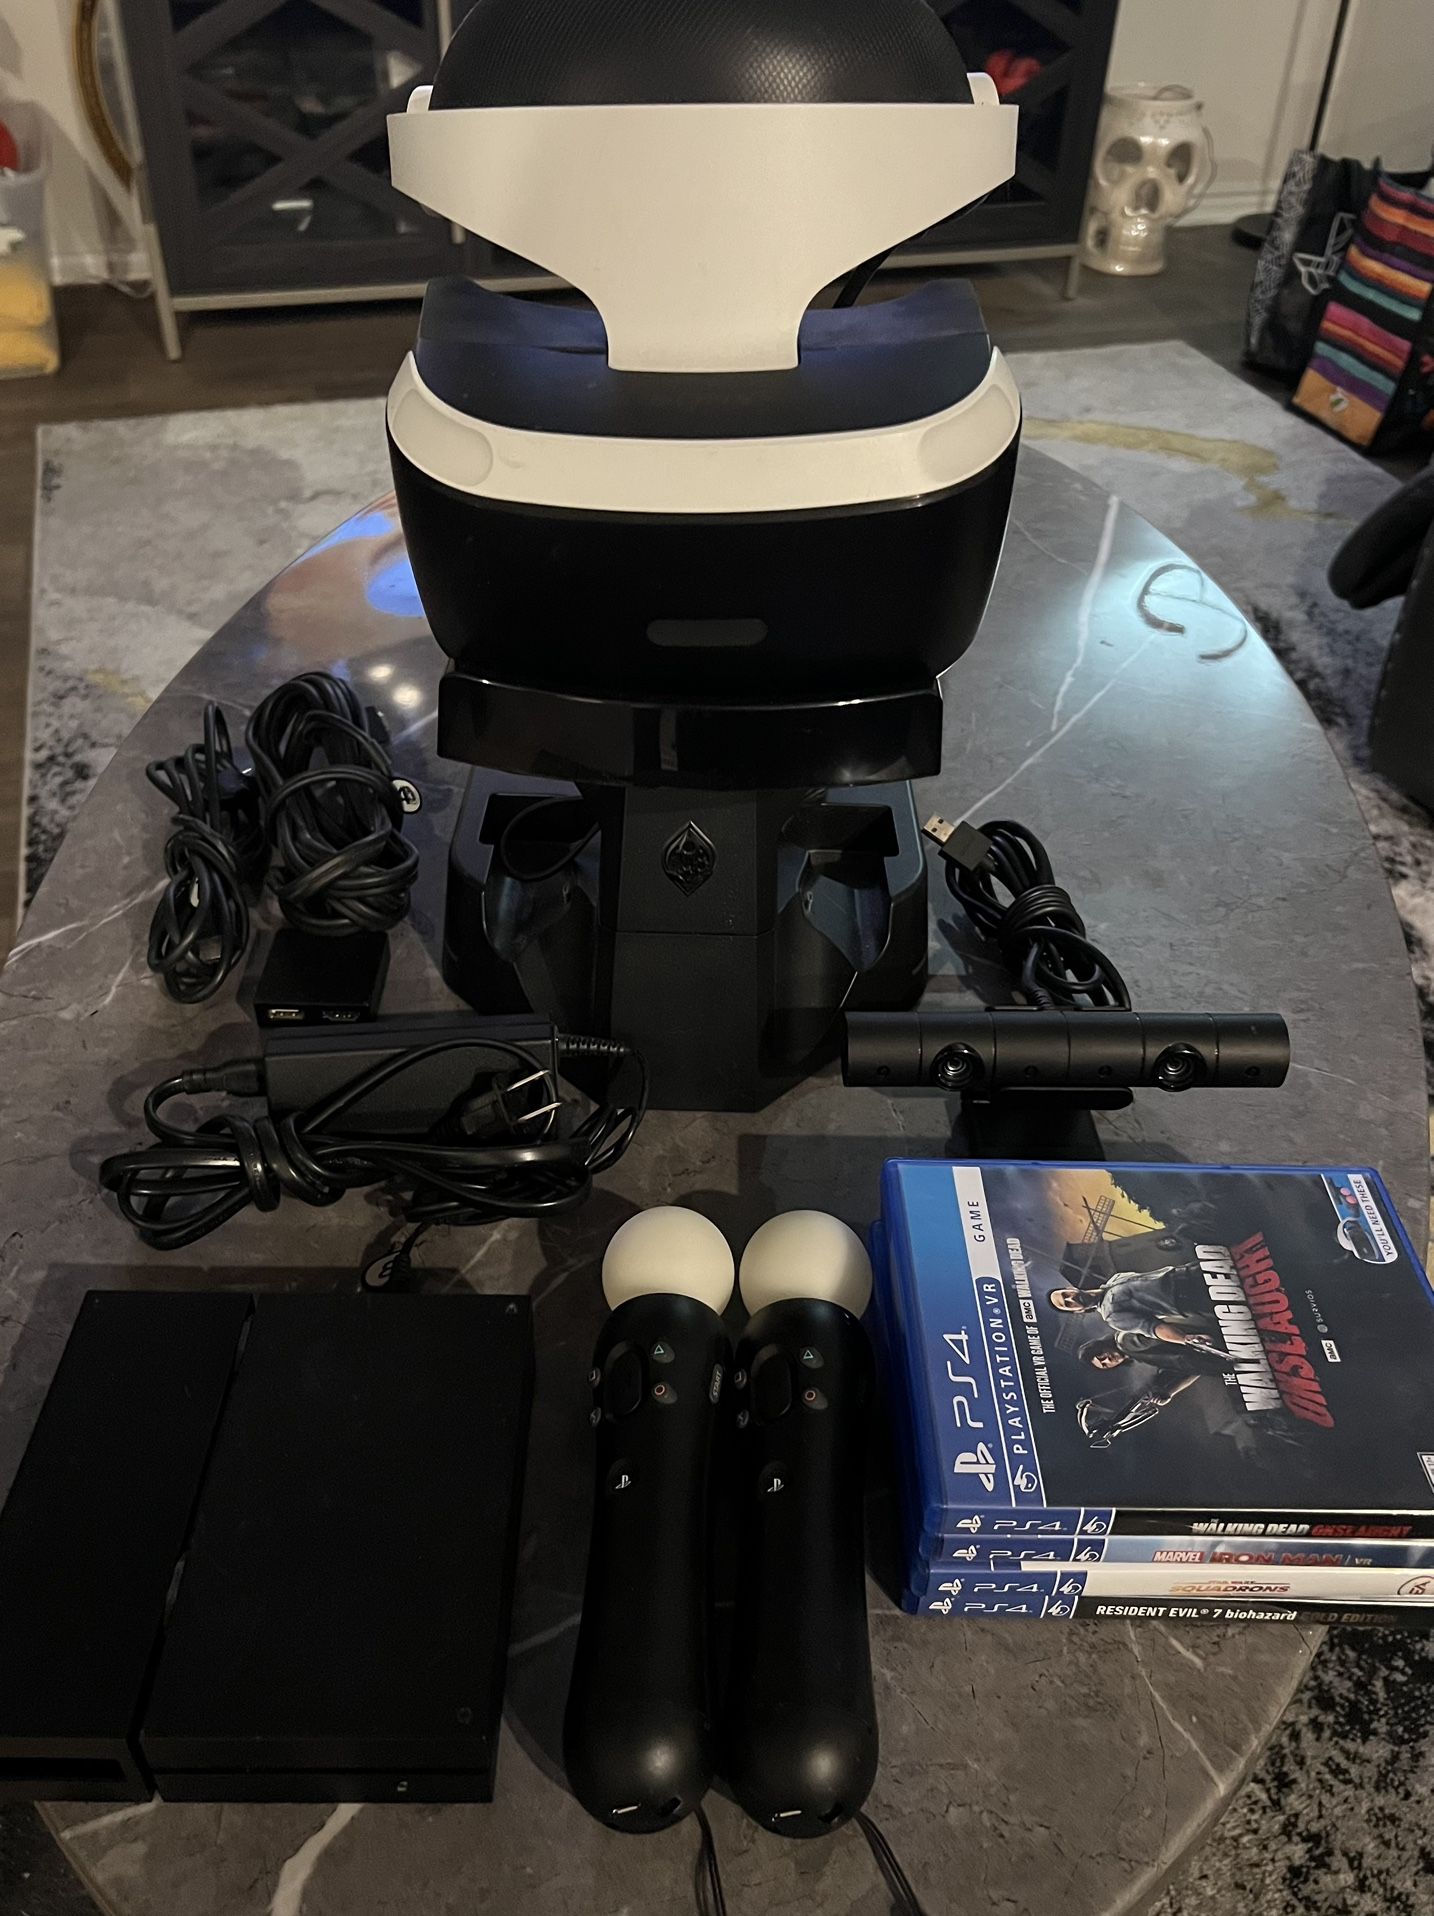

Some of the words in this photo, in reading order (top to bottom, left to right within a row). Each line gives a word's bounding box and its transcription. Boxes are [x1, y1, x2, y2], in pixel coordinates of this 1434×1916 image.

[1353, 1179, 1370, 1203] THESE
[967, 1201, 985, 1242] GAME
[1364, 1205, 1380, 1226] NEED
[1007, 1238, 1023, 1260] DEAD
[1375, 1228, 1393, 1256] YOU'LL
[1195, 1243, 1246, 1301] DEAD
[1026, 1326, 1039, 1335] OF
[1230, 1231, 1335, 1429] ONSLAUGHT
[1028, 1334, 1043, 1355] GAME
[1031, 1355, 1045, 1366] VR
[1213, 1304, 1282, 1411] WALKING
[943, 1332, 984, 1428] PS4
[1036, 1366, 1052, 1397] OFFICIAL
[1222, 1372, 1237, 1386] THE
[1043, 1397, 1055, 1413] THE
[993, 1520, 1062, 1530] PS4
[1191, 1522, 1265, 1535] WALKING
[1265, 1523, 1310, 1536] DEAD
[989, 1550, 1057, 1560] PS4
[1152, 1551, 1203, 1563] MARVEL
[1210, 1552, 1276, 1565] IRON
[1281, 1553, 1344, 1566] MAN
[1354, 1558, 1373, 1566] VR
[973, 1583, 1041, 1593] PS4
[1169, 1585, 1290, 1593] SQUADRONS
[963, 1603, 1030, 1613] PS4
[1096, 1605, 1166, 1618] RESIDENT
[1213, 1609, 1223, 1619] 7
[1225, 1608, 1297, 1621] biohazard
